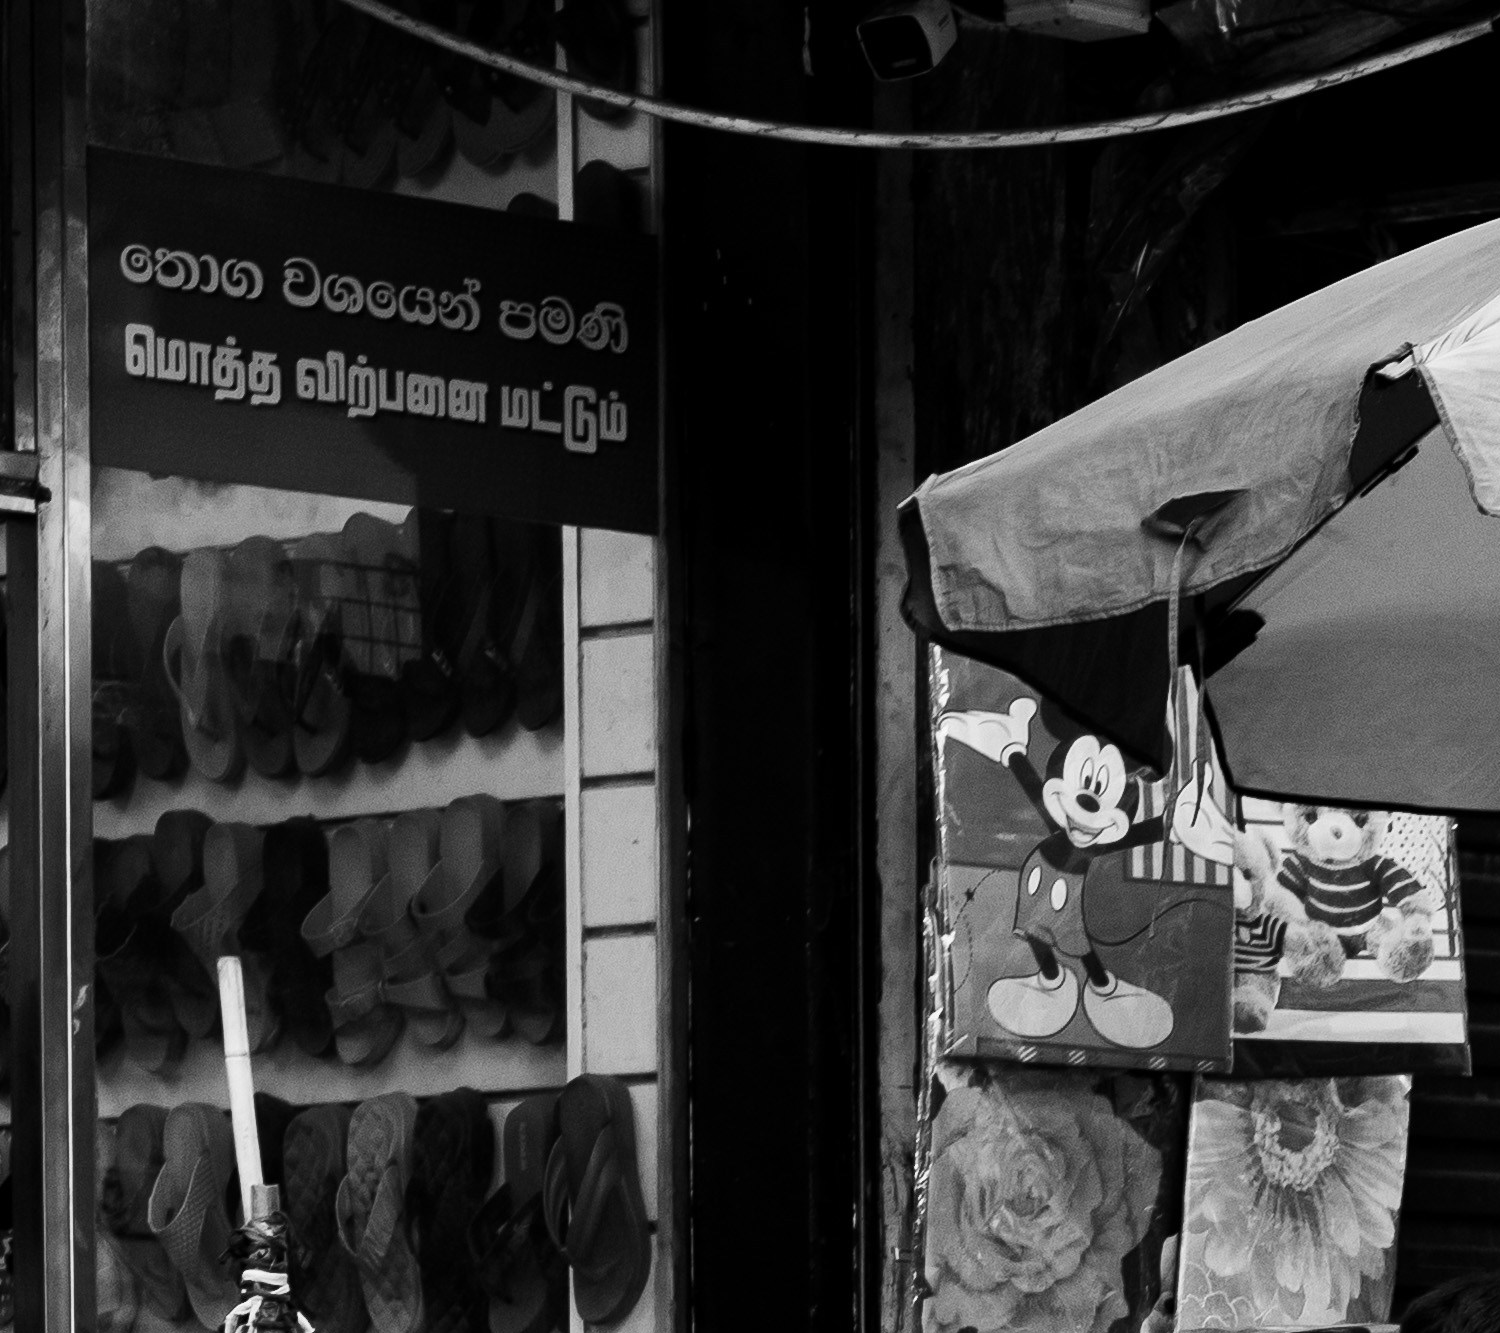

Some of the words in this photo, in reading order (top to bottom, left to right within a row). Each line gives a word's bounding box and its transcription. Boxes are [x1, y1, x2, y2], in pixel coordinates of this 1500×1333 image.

[120, 242, 264, 300] තොග
[283, 257, 481, 331] වශයෙන්
[500, 296, 628, 353] පමණි
[124, 322, 281, 406] மொத்த
[296, 350, 488, 422] விற்பனை
[500, 381, 628, 453] மட்டும்
